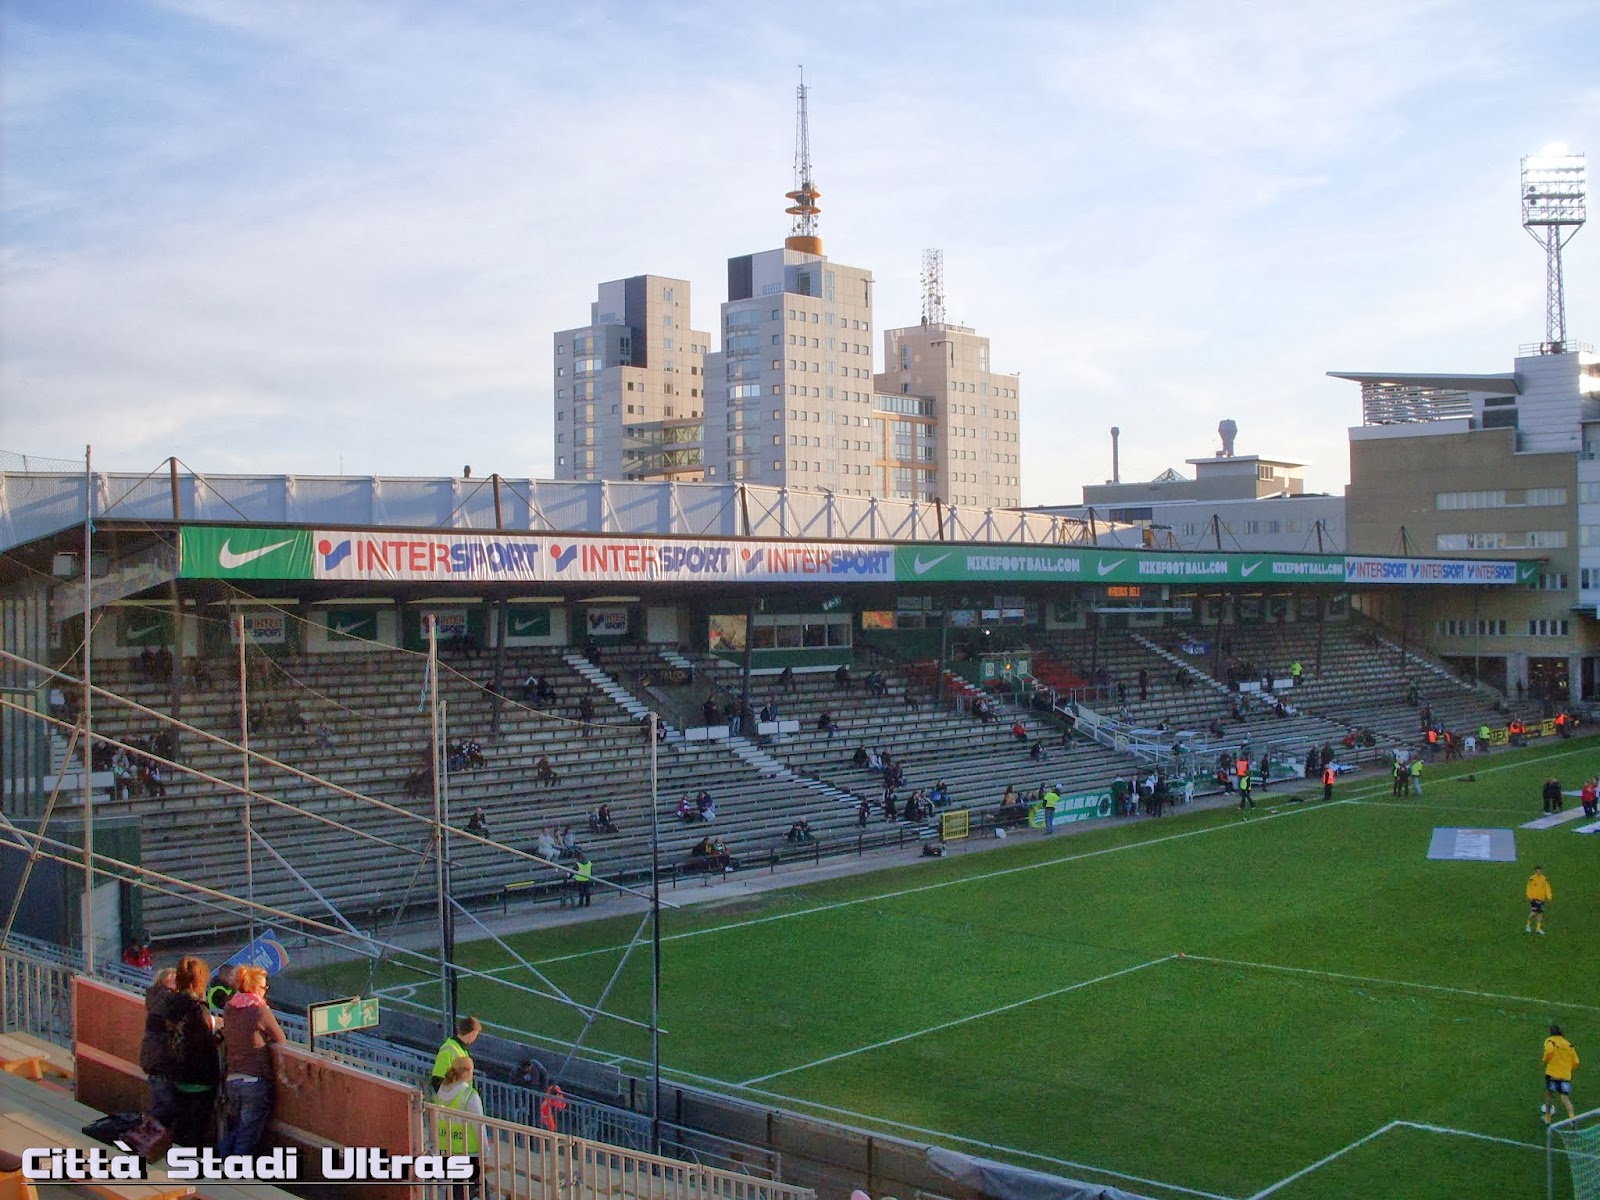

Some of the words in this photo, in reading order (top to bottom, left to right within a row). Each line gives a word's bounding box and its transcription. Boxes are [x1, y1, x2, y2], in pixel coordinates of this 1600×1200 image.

[357, 539, 539, 573] INTERSPORT
[582, 544, 731, 573] INTERSPORT
[767, 548, 891, 575] INTERSPORT
[967, 555, 1080, 572] NIKEFOOTBALL.COM
[1138, 560, 1228, 575] NIKEFOOTBALL.COM
[1272, 561, 1343, 575] NIKEFOOTBALL.COM
[1356, 561, 1408, 579] INTERSPORT
[1420, 562, 1465, 580] INTERSPORT
[1474, 564, 1516, 581] INTERSPORT
